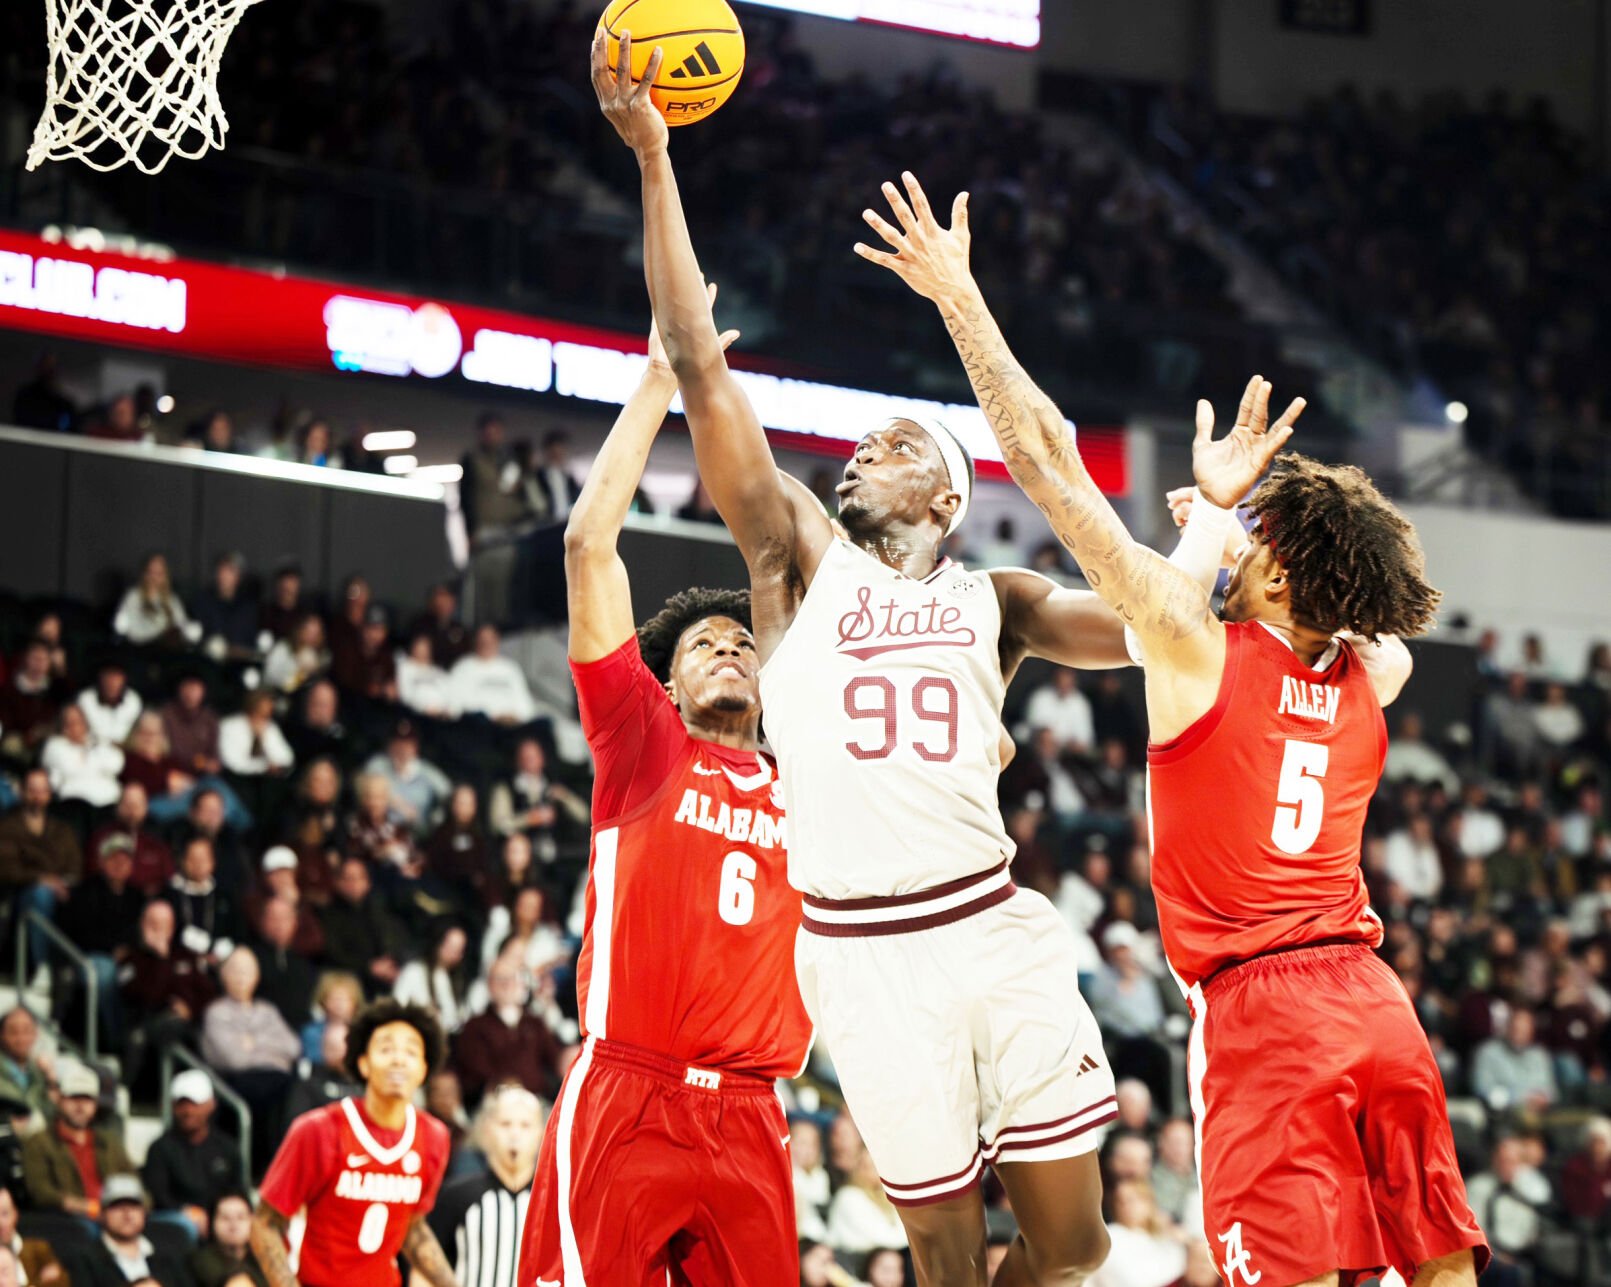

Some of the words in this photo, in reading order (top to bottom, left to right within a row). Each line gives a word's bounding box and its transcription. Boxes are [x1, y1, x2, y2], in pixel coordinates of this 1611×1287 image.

[666, 97, 716, 113] PRO
[834, 586, 975, 655] State
[843, 676, 958, 763] 99
[1277, 674, 1341, 725] ALLEN
[674, 788, 788, 850] ALABAM
[1270, 738, 1330, 855] 5
[718, 850, 757, 926] 6
[357, 1201, 389, 1255] 0
